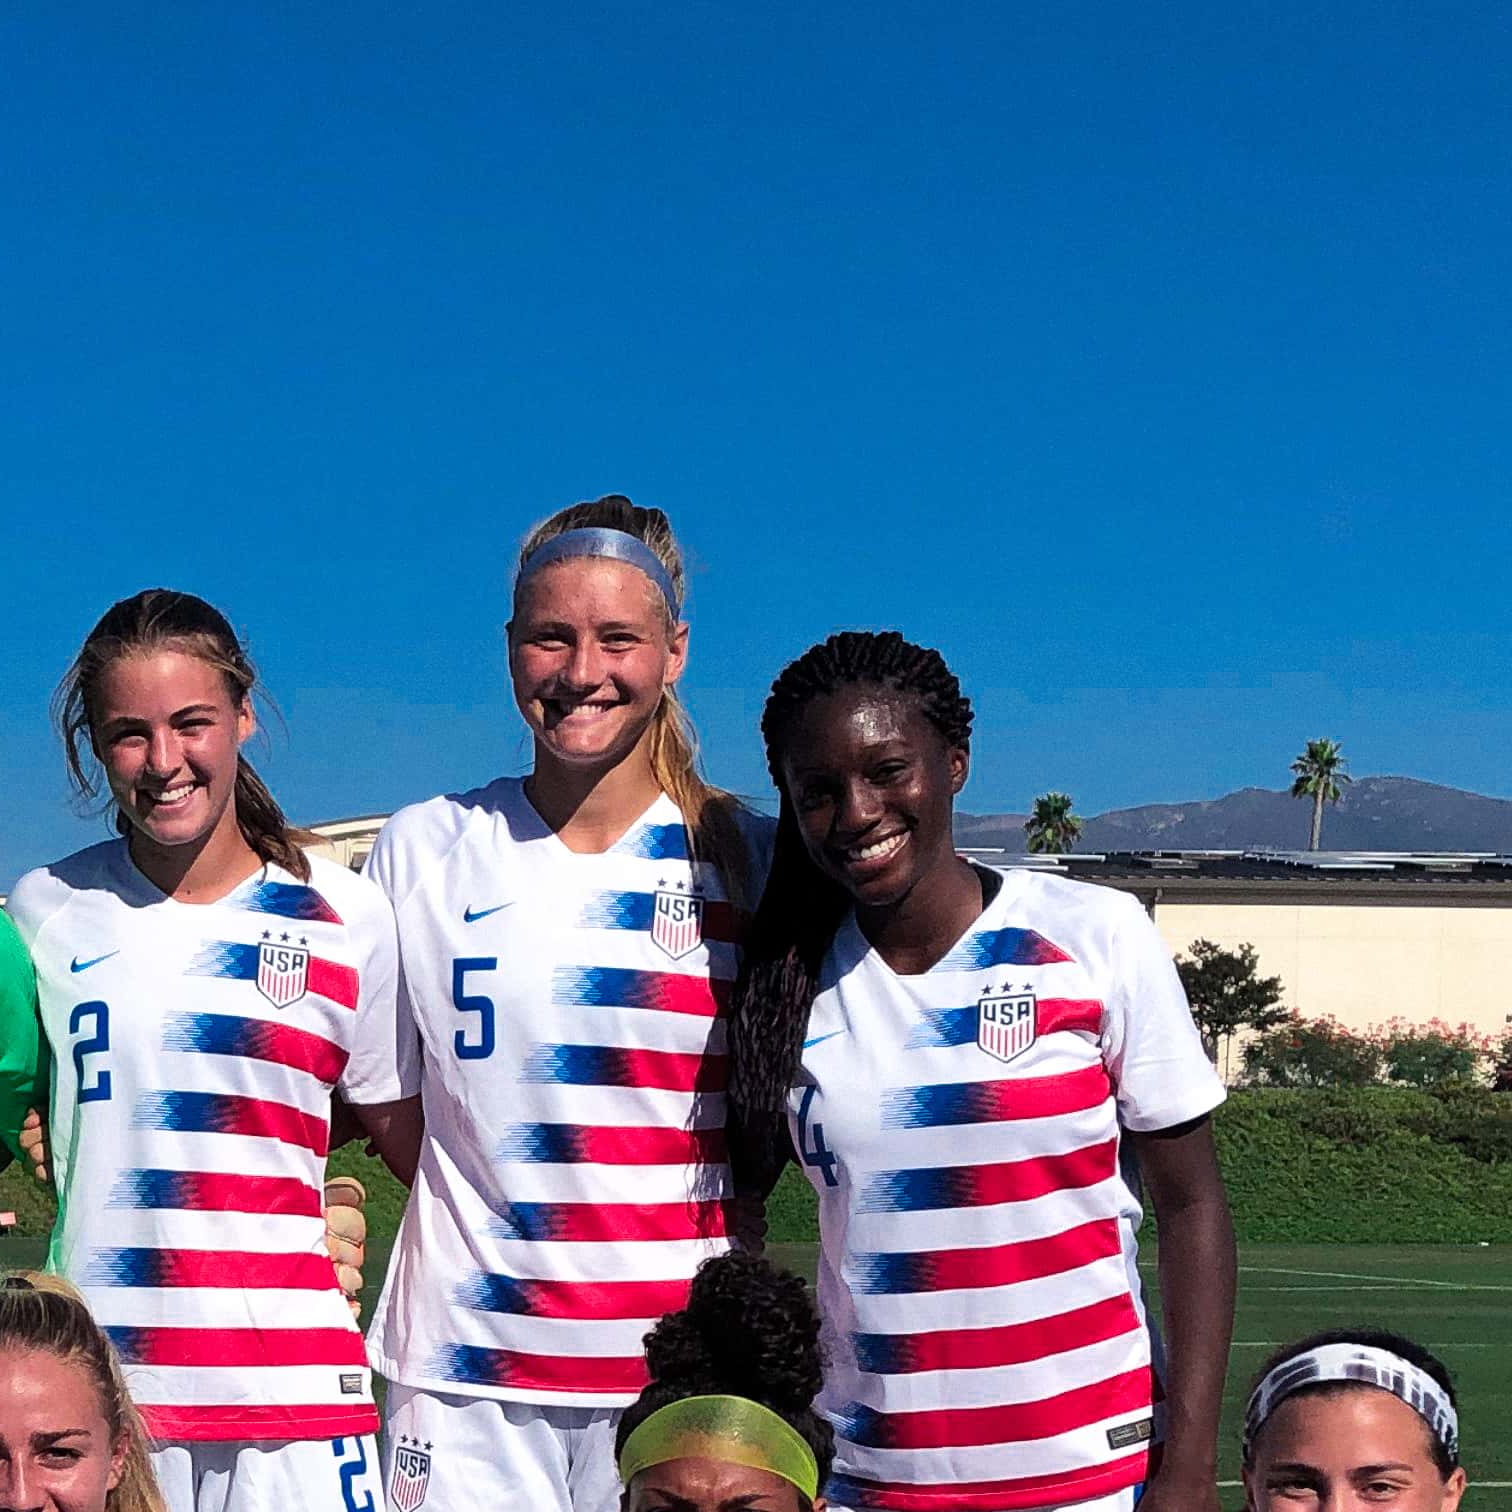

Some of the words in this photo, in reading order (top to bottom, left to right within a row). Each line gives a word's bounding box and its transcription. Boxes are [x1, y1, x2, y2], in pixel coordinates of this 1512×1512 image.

[659, 896, 698, 921] USA
[263, 948, 304, 972] USA
[452, 957, 497, 1060] 5
[983, 1001, 1030, 1025] USA
[69, 1000, 112, 1104] 2
[798, 1084, 838, 1186] 4
[400, 1452, 428, 1479] USA
